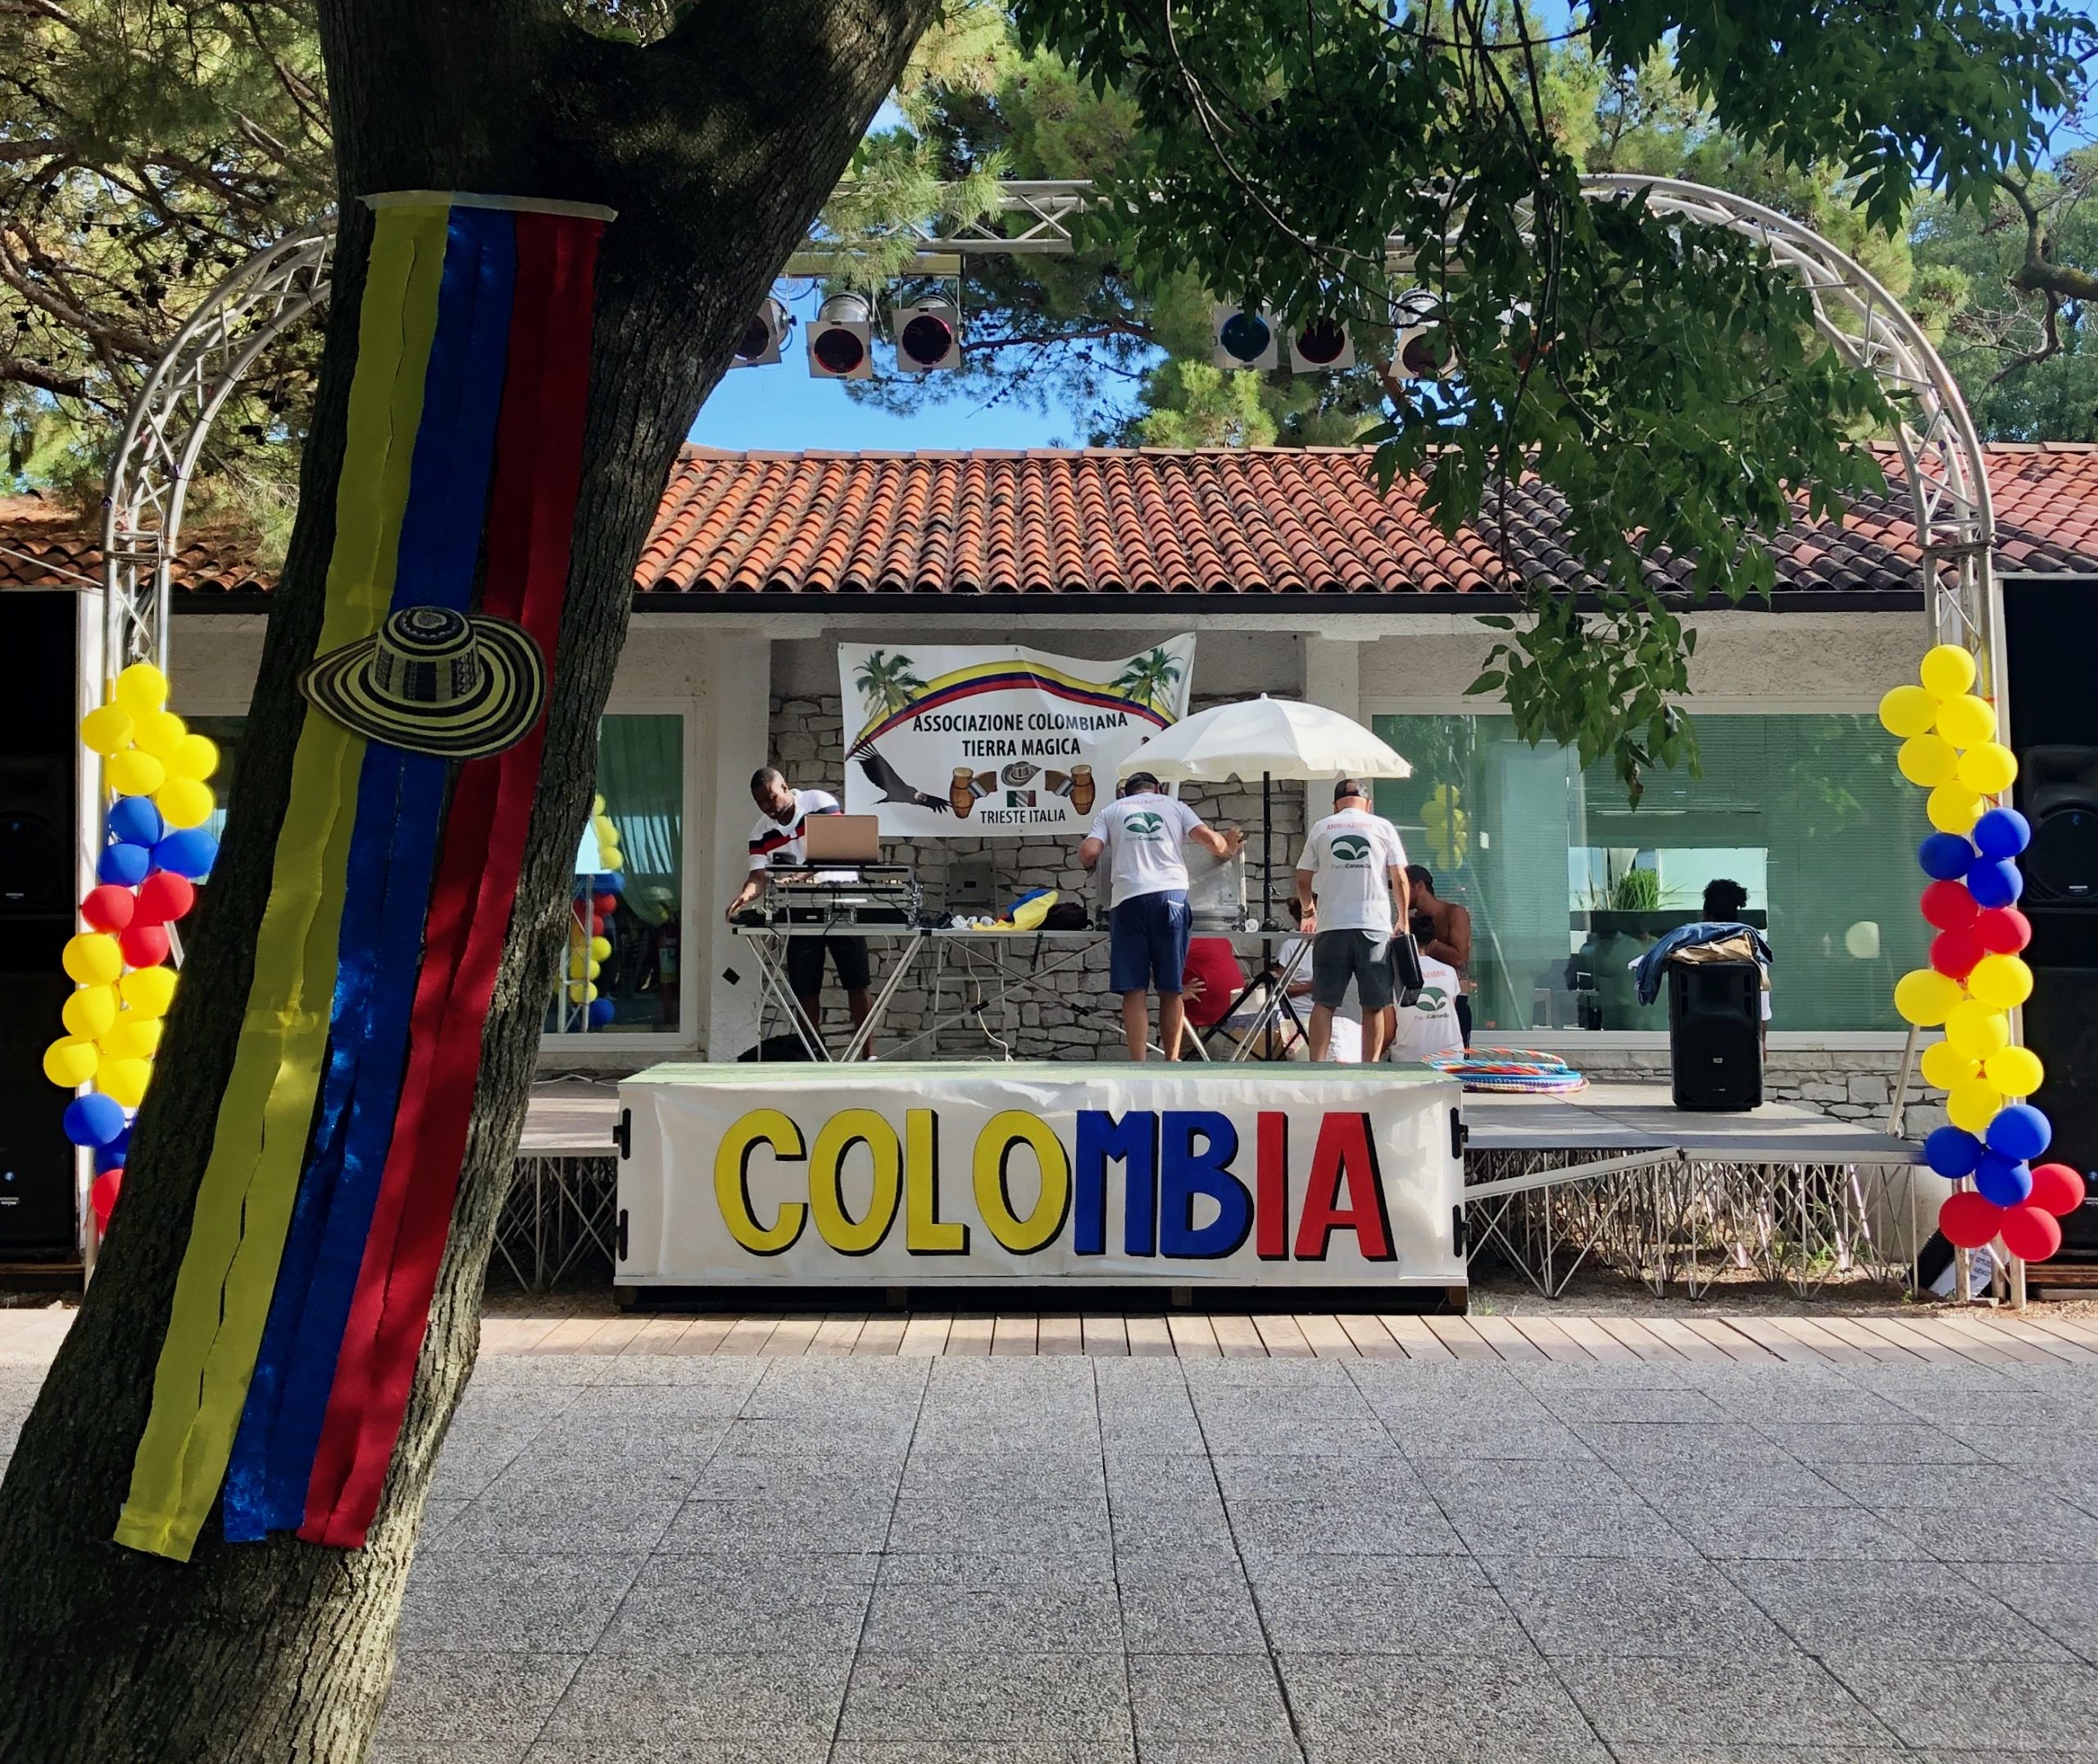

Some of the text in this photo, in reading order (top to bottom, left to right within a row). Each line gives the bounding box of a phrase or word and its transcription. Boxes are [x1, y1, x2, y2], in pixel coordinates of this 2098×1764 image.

[913, 712, 1128, 732] ASSOCIAZIONE COLOMBIANA
[962, 737, 1081, 757] TIERRA MAGICA
[980, 809, 1066, 824] TRIESTE ITALIA
[1327, 822, 1374, 831] ANIMAZIONE
[1423, 969, 1447, 978] AZIONE
[714, 1108, 1397, 1262] COLOMBIA
